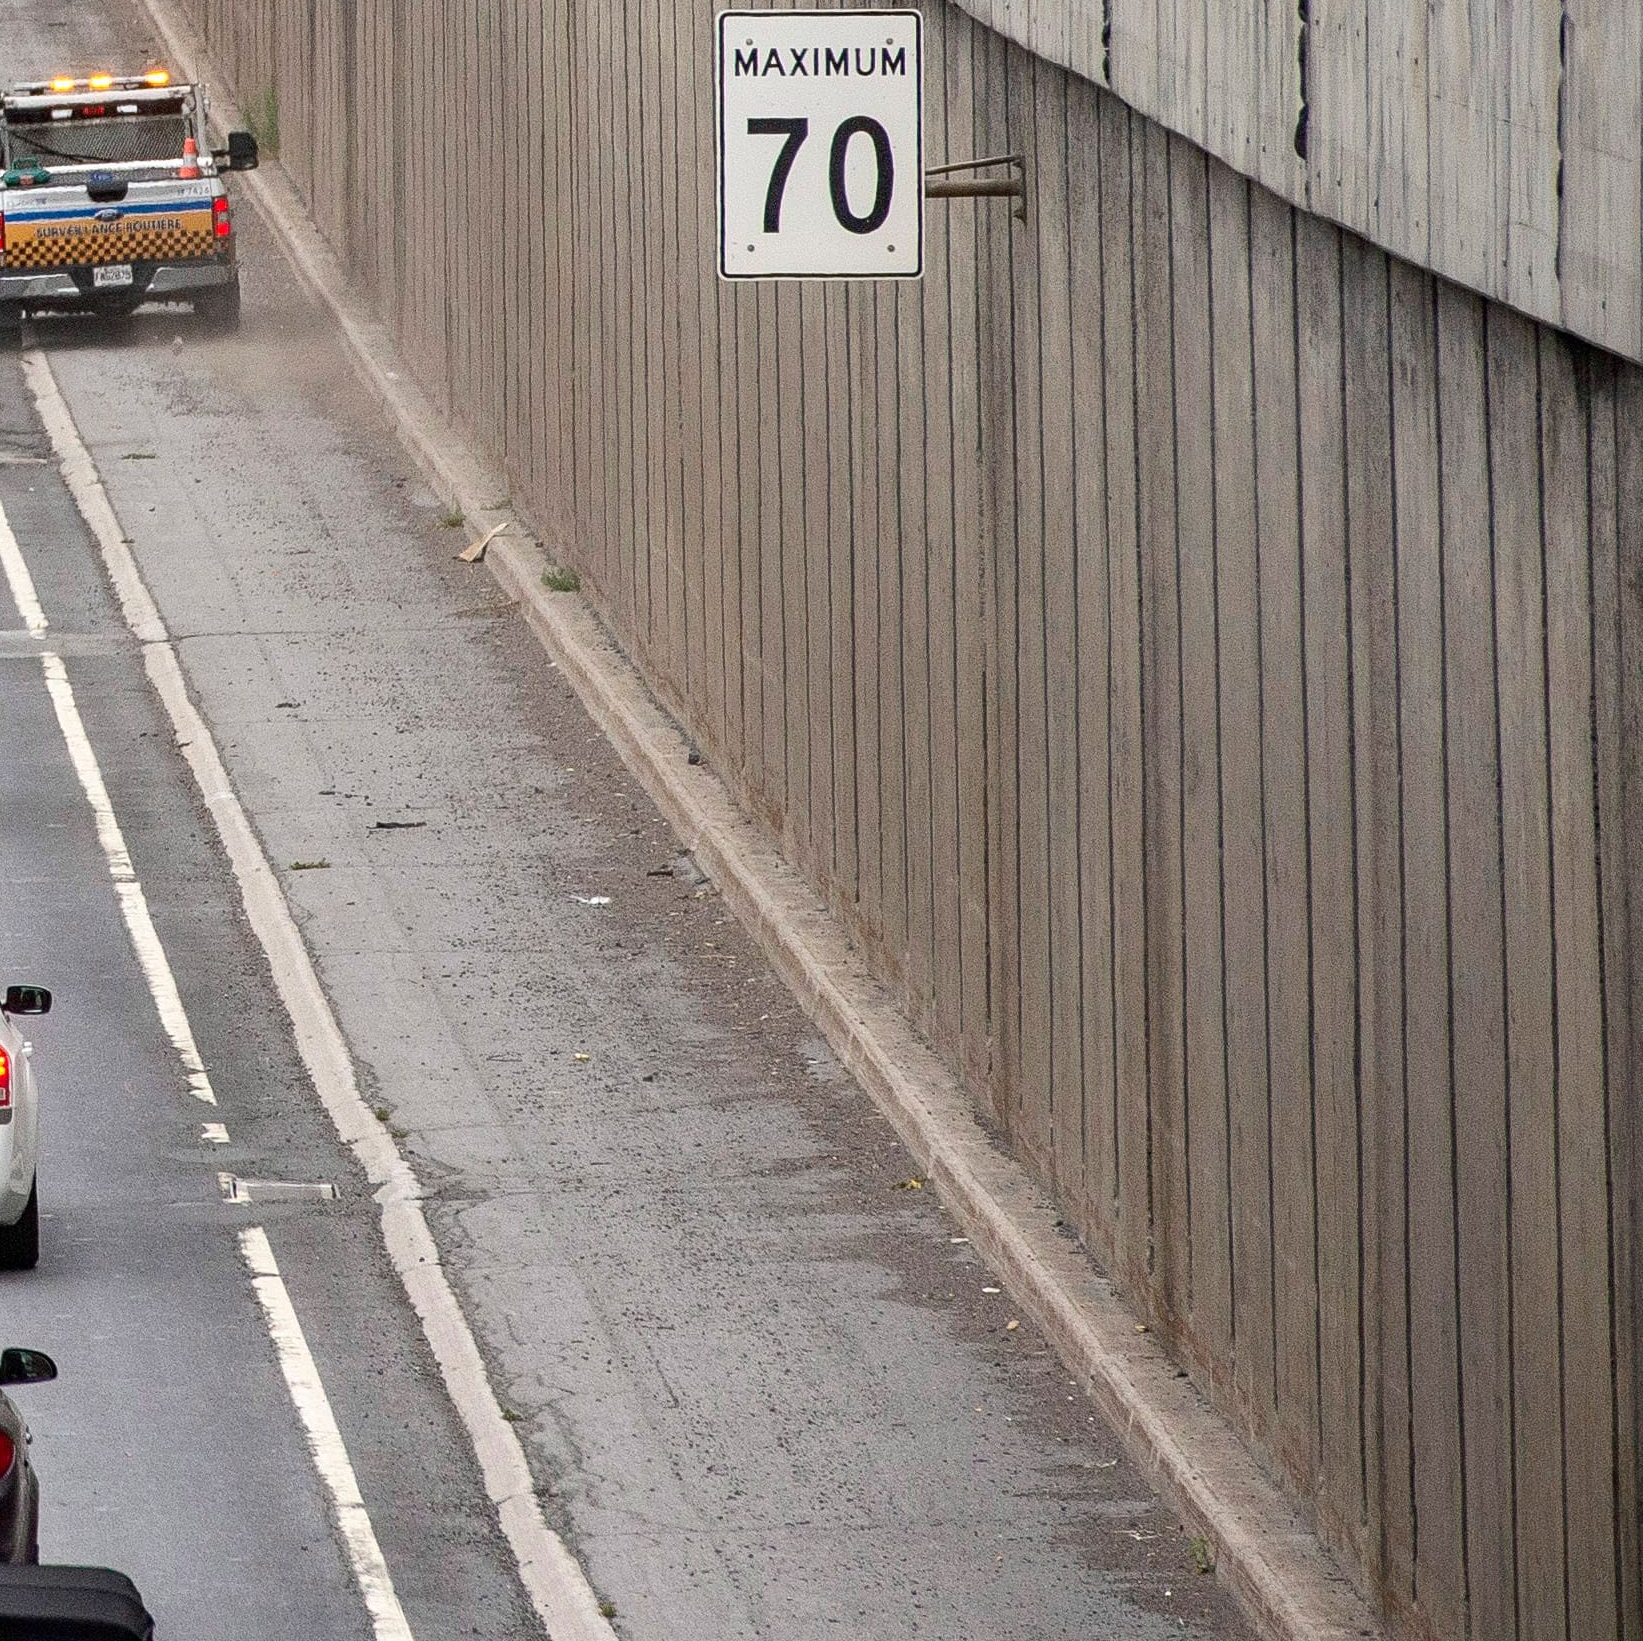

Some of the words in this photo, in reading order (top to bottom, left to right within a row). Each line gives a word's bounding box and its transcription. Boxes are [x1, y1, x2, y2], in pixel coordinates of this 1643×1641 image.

[736, 48, 905, 75] MAXIMUM
[748, 116, 893, 234] 70
[36, 223, 123, 238] SURVEILLANCE
